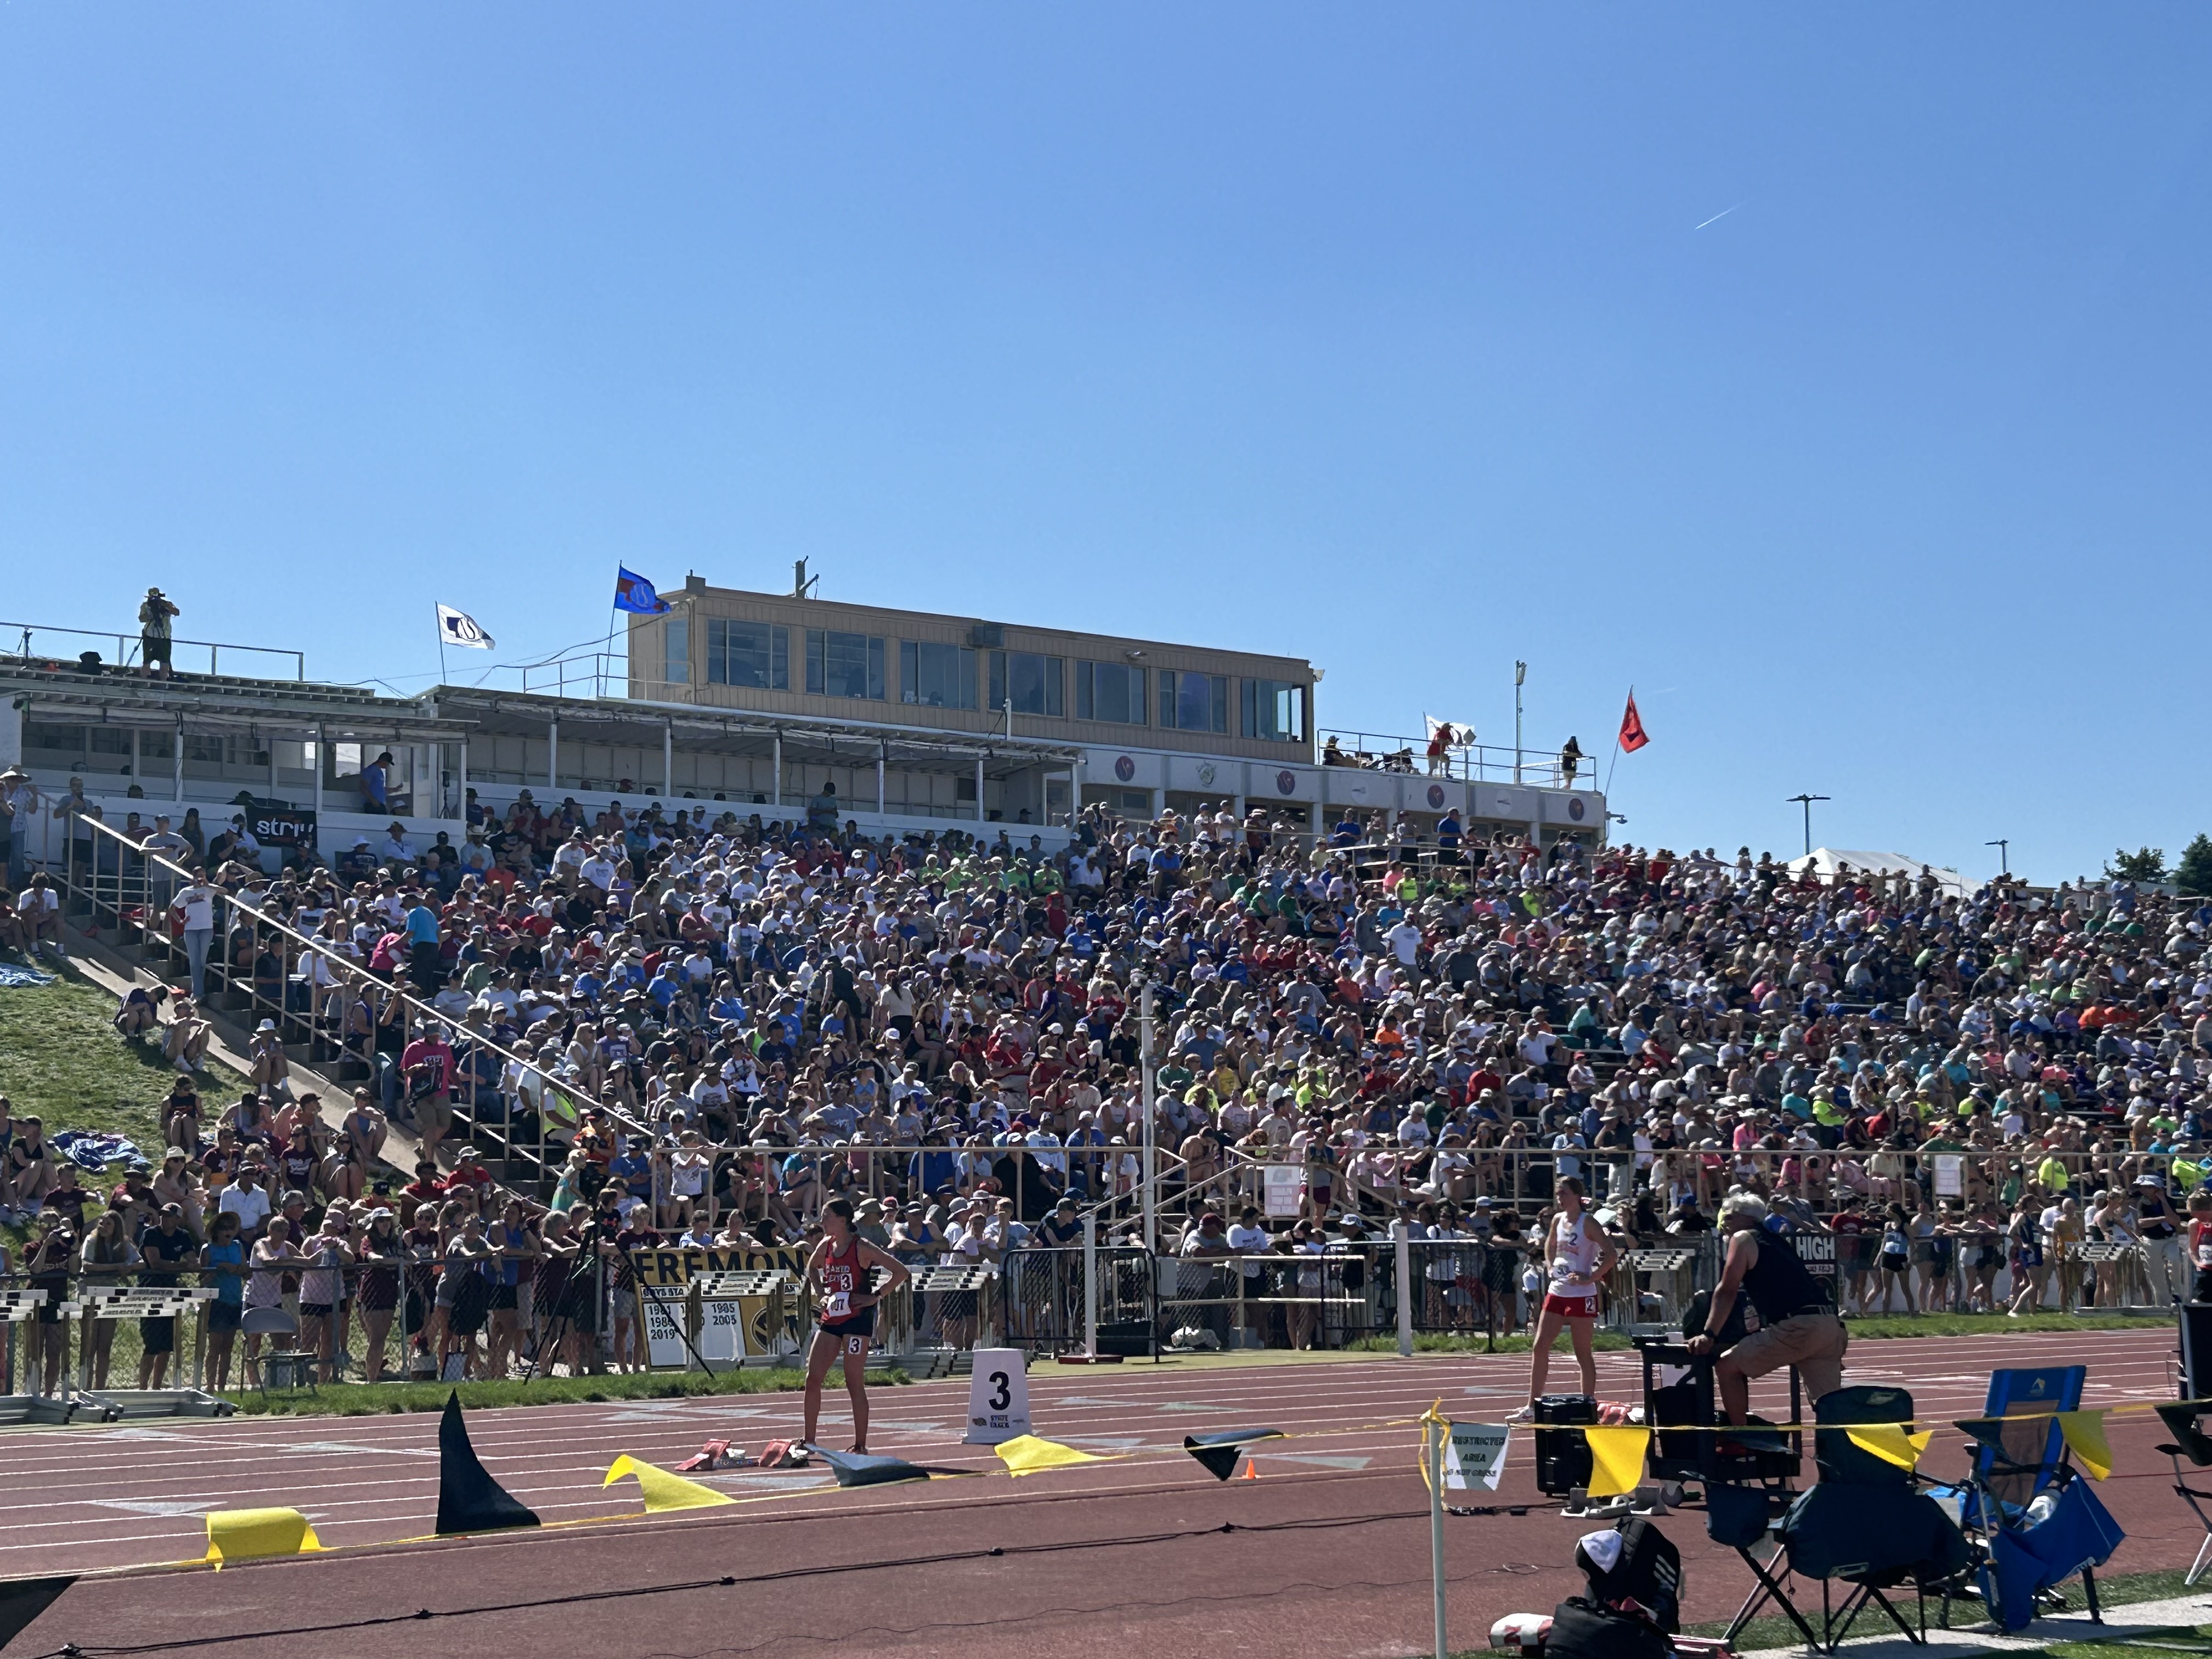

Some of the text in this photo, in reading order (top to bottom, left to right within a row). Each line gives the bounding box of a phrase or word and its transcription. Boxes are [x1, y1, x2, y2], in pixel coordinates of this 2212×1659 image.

[1568, 1232, 1578, 1246] 2
[1796, 1236, 1836, 1260] HIGH
[635, 1250, 805, 1284] FREMON
[842, 1274, 851, 1290] 3
[1585, 1297, 1594, 1312] 2
[651, 1328, 675, 1340] 2019
[850, 1338, 860, 1354] 3
[989, 1371, 1011, 1410] 3
